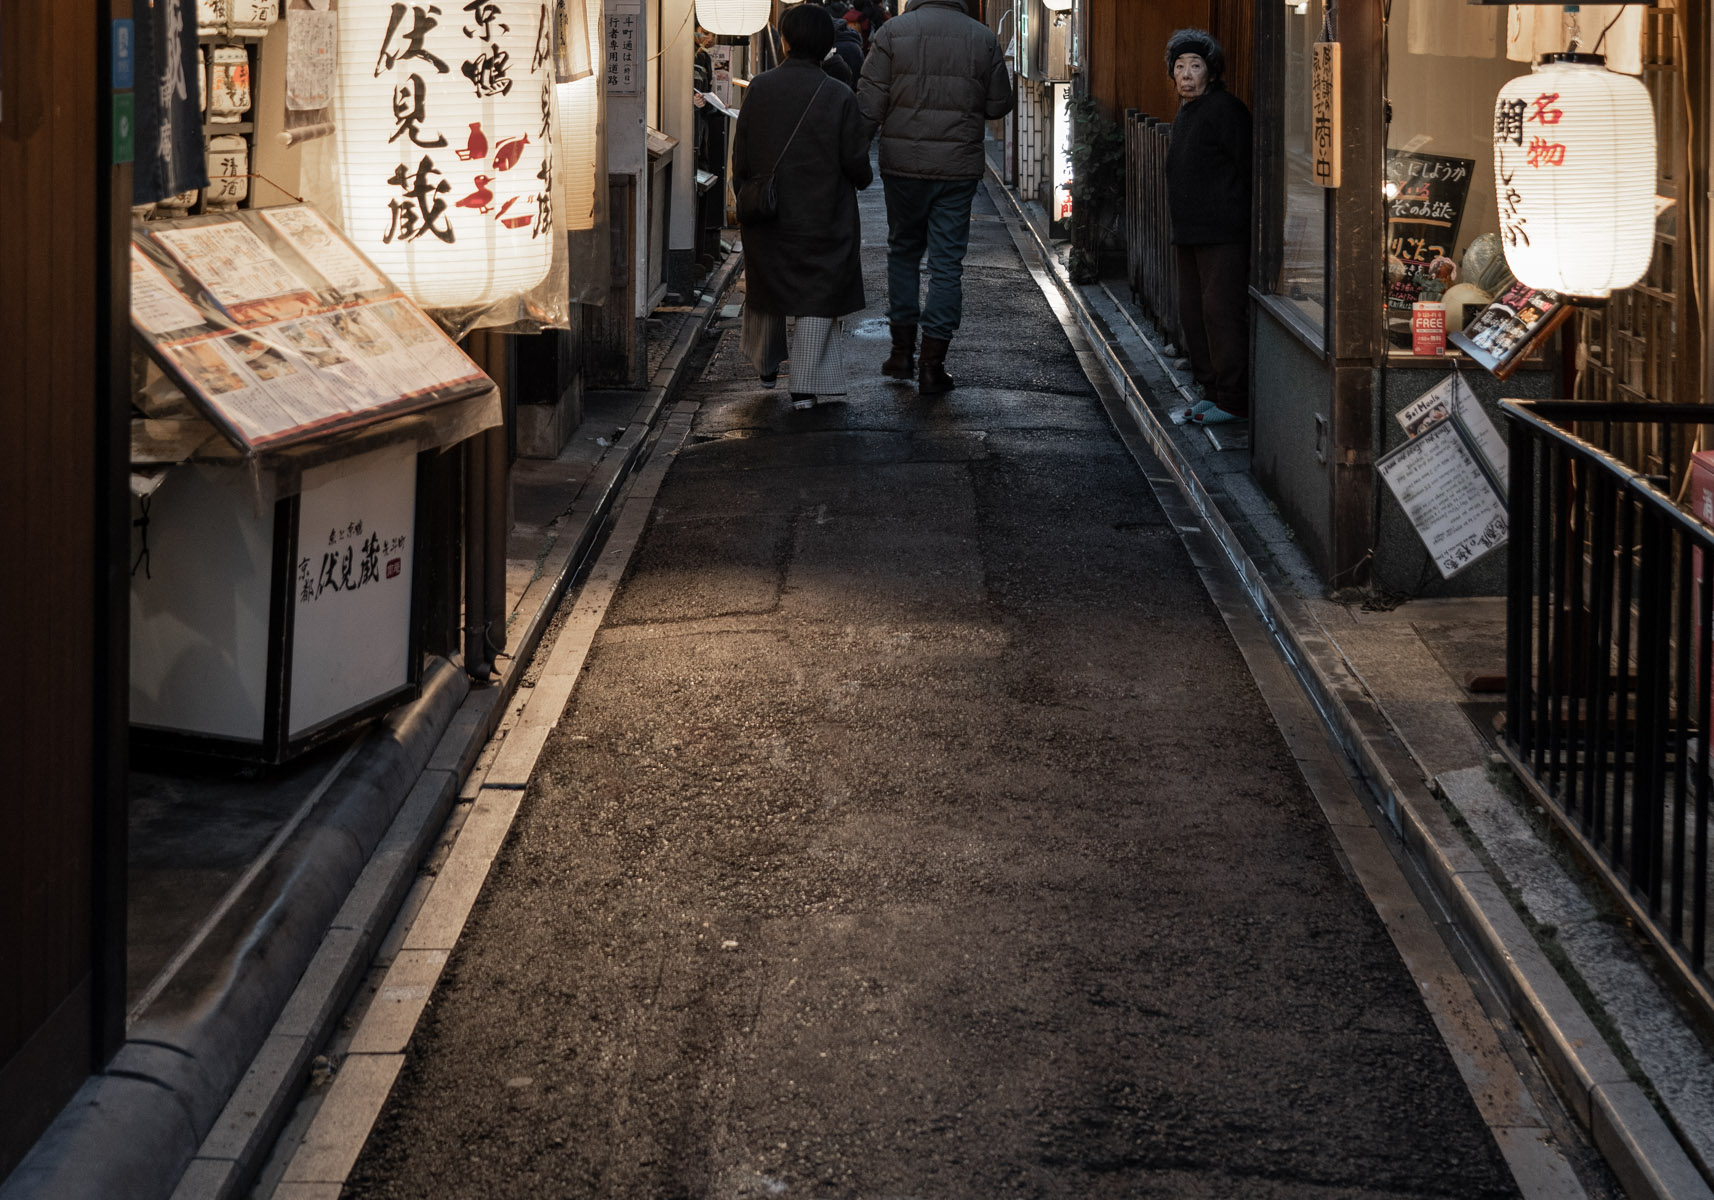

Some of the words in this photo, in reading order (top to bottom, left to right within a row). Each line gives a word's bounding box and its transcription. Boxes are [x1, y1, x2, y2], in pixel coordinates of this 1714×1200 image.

[608, 16, 620, 86] 行者専用道路
[622, 16, 634, 86] 斗町通は（終日）
[1526, 92, 1567, 170] 名物
[219, 157, 239, 197] 清酒
[1390, 237, 1446, 261] りごたつ
[1416, 318, 1443, 328] FREE
